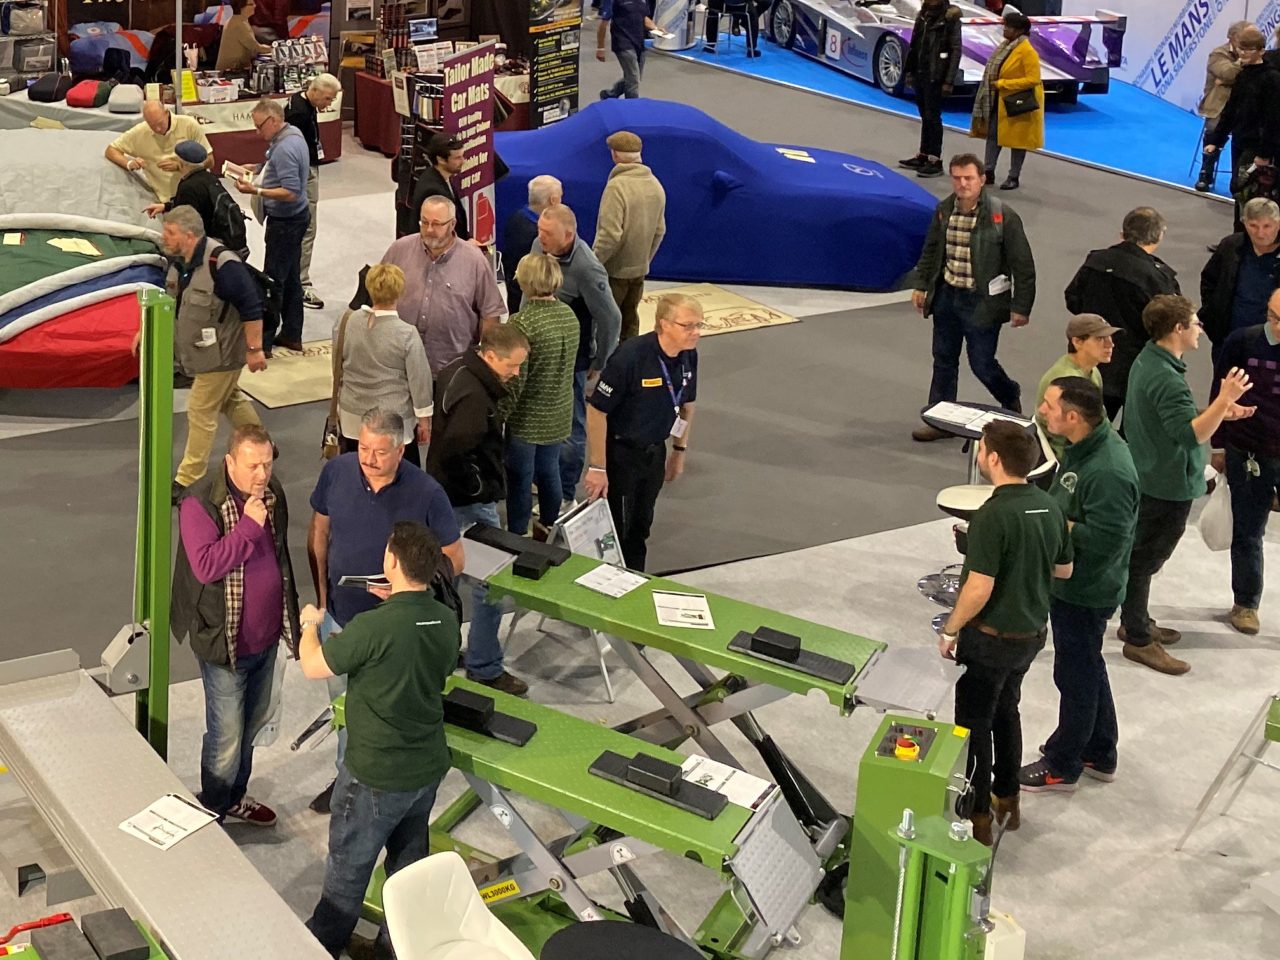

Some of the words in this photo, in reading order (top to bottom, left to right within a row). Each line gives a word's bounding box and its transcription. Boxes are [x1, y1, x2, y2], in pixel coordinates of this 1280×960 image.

[829, 33, 837, 54] 8
[1172, 16, 1213, 73] SILVERSTONE
[444, 62, 470, 88] Tailor
[471, 52, 495, 78] Made
[1150, 52, 1169, 88] LE
[451, 92, 467, 113] Car
[467, 83, 490, 106] Mats
[599, 380, 614, 394] BMW
[481, 883, 516, 900] WL3000KG
